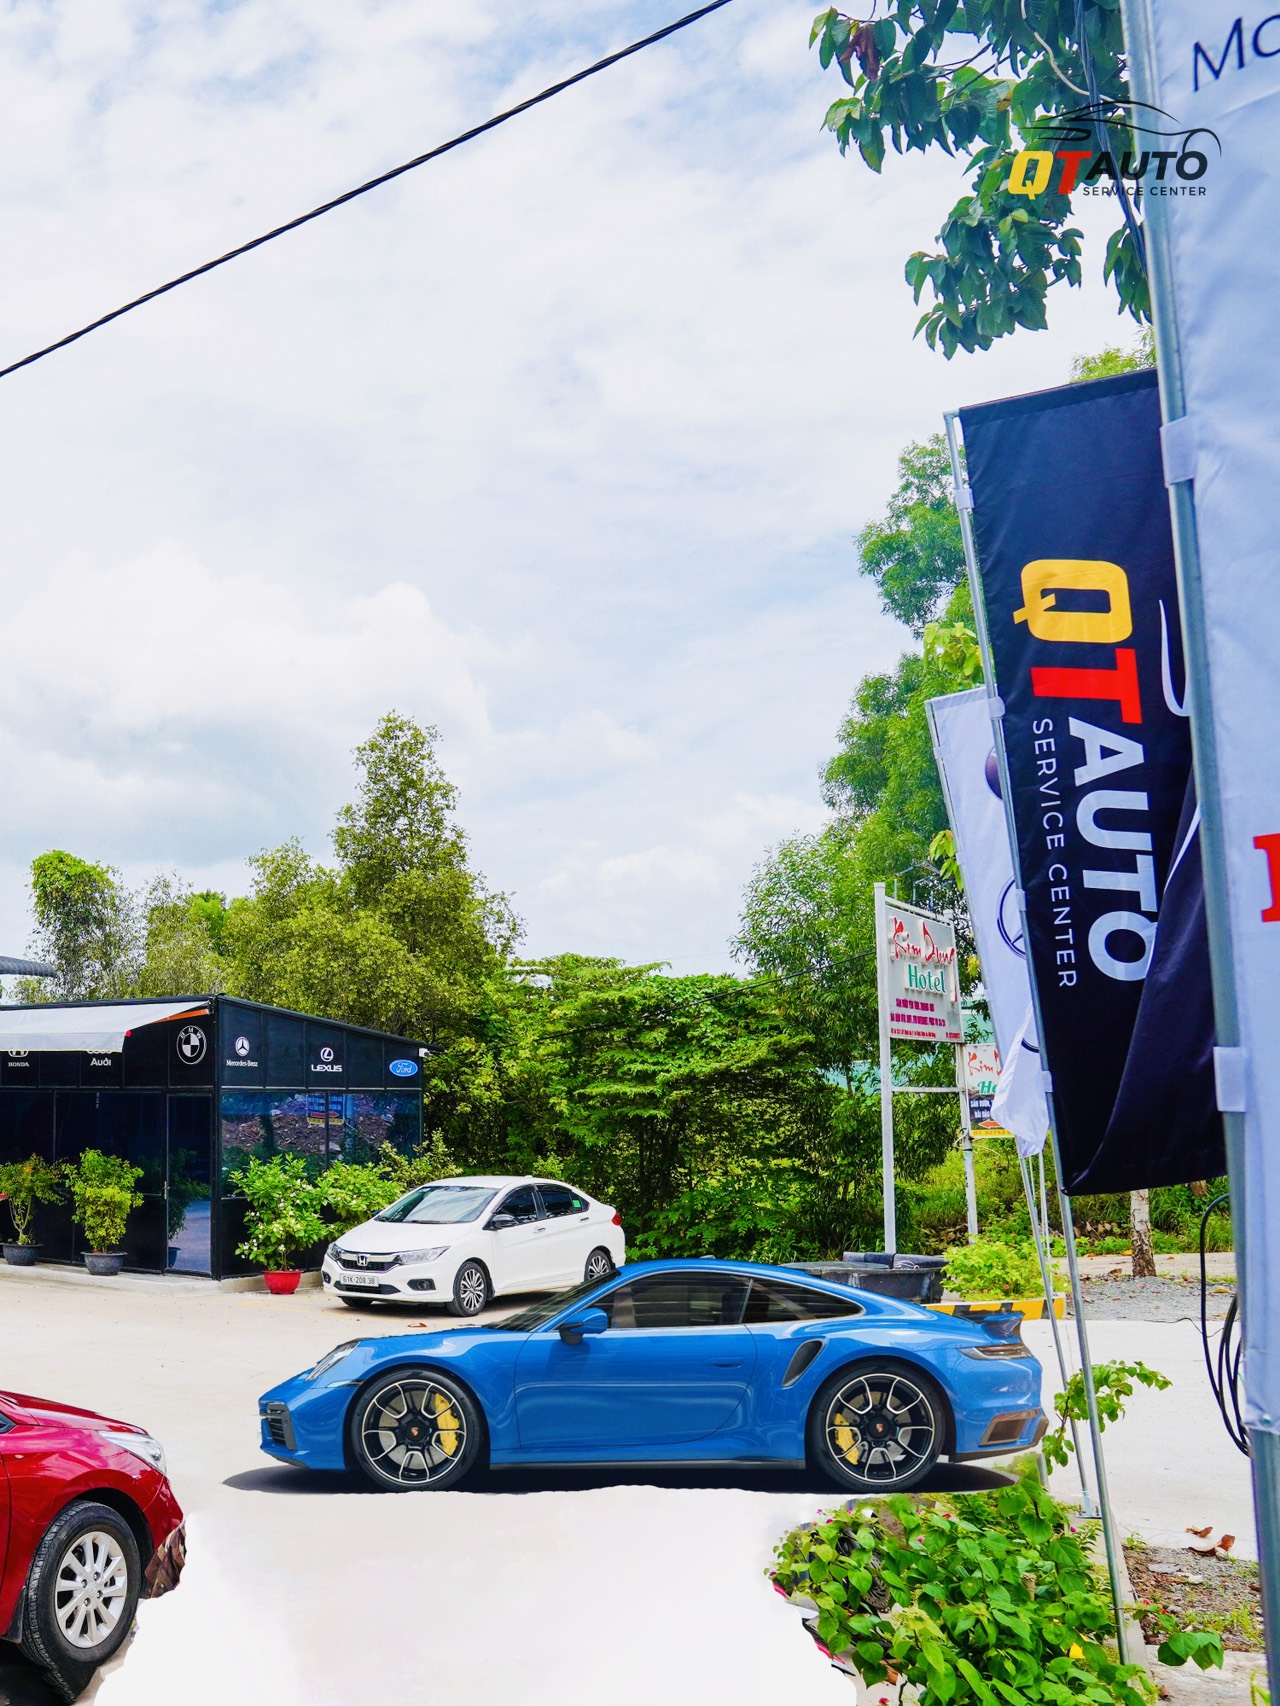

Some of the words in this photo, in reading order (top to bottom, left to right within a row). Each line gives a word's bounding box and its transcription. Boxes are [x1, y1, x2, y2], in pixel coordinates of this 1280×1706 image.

[1032, 718, 1064, 850] SERVICE
[1048, 863, 1077, 988] CENTER
[907, 963, 946, 993] Hotel
[90, 1057, 112, 1066] Audi
[226, 1059, 258, 1067] Mercedes-Benz
[311, 1064, 342, 1072] LEXUS
[968, 1051, 994, 1076] Kim
